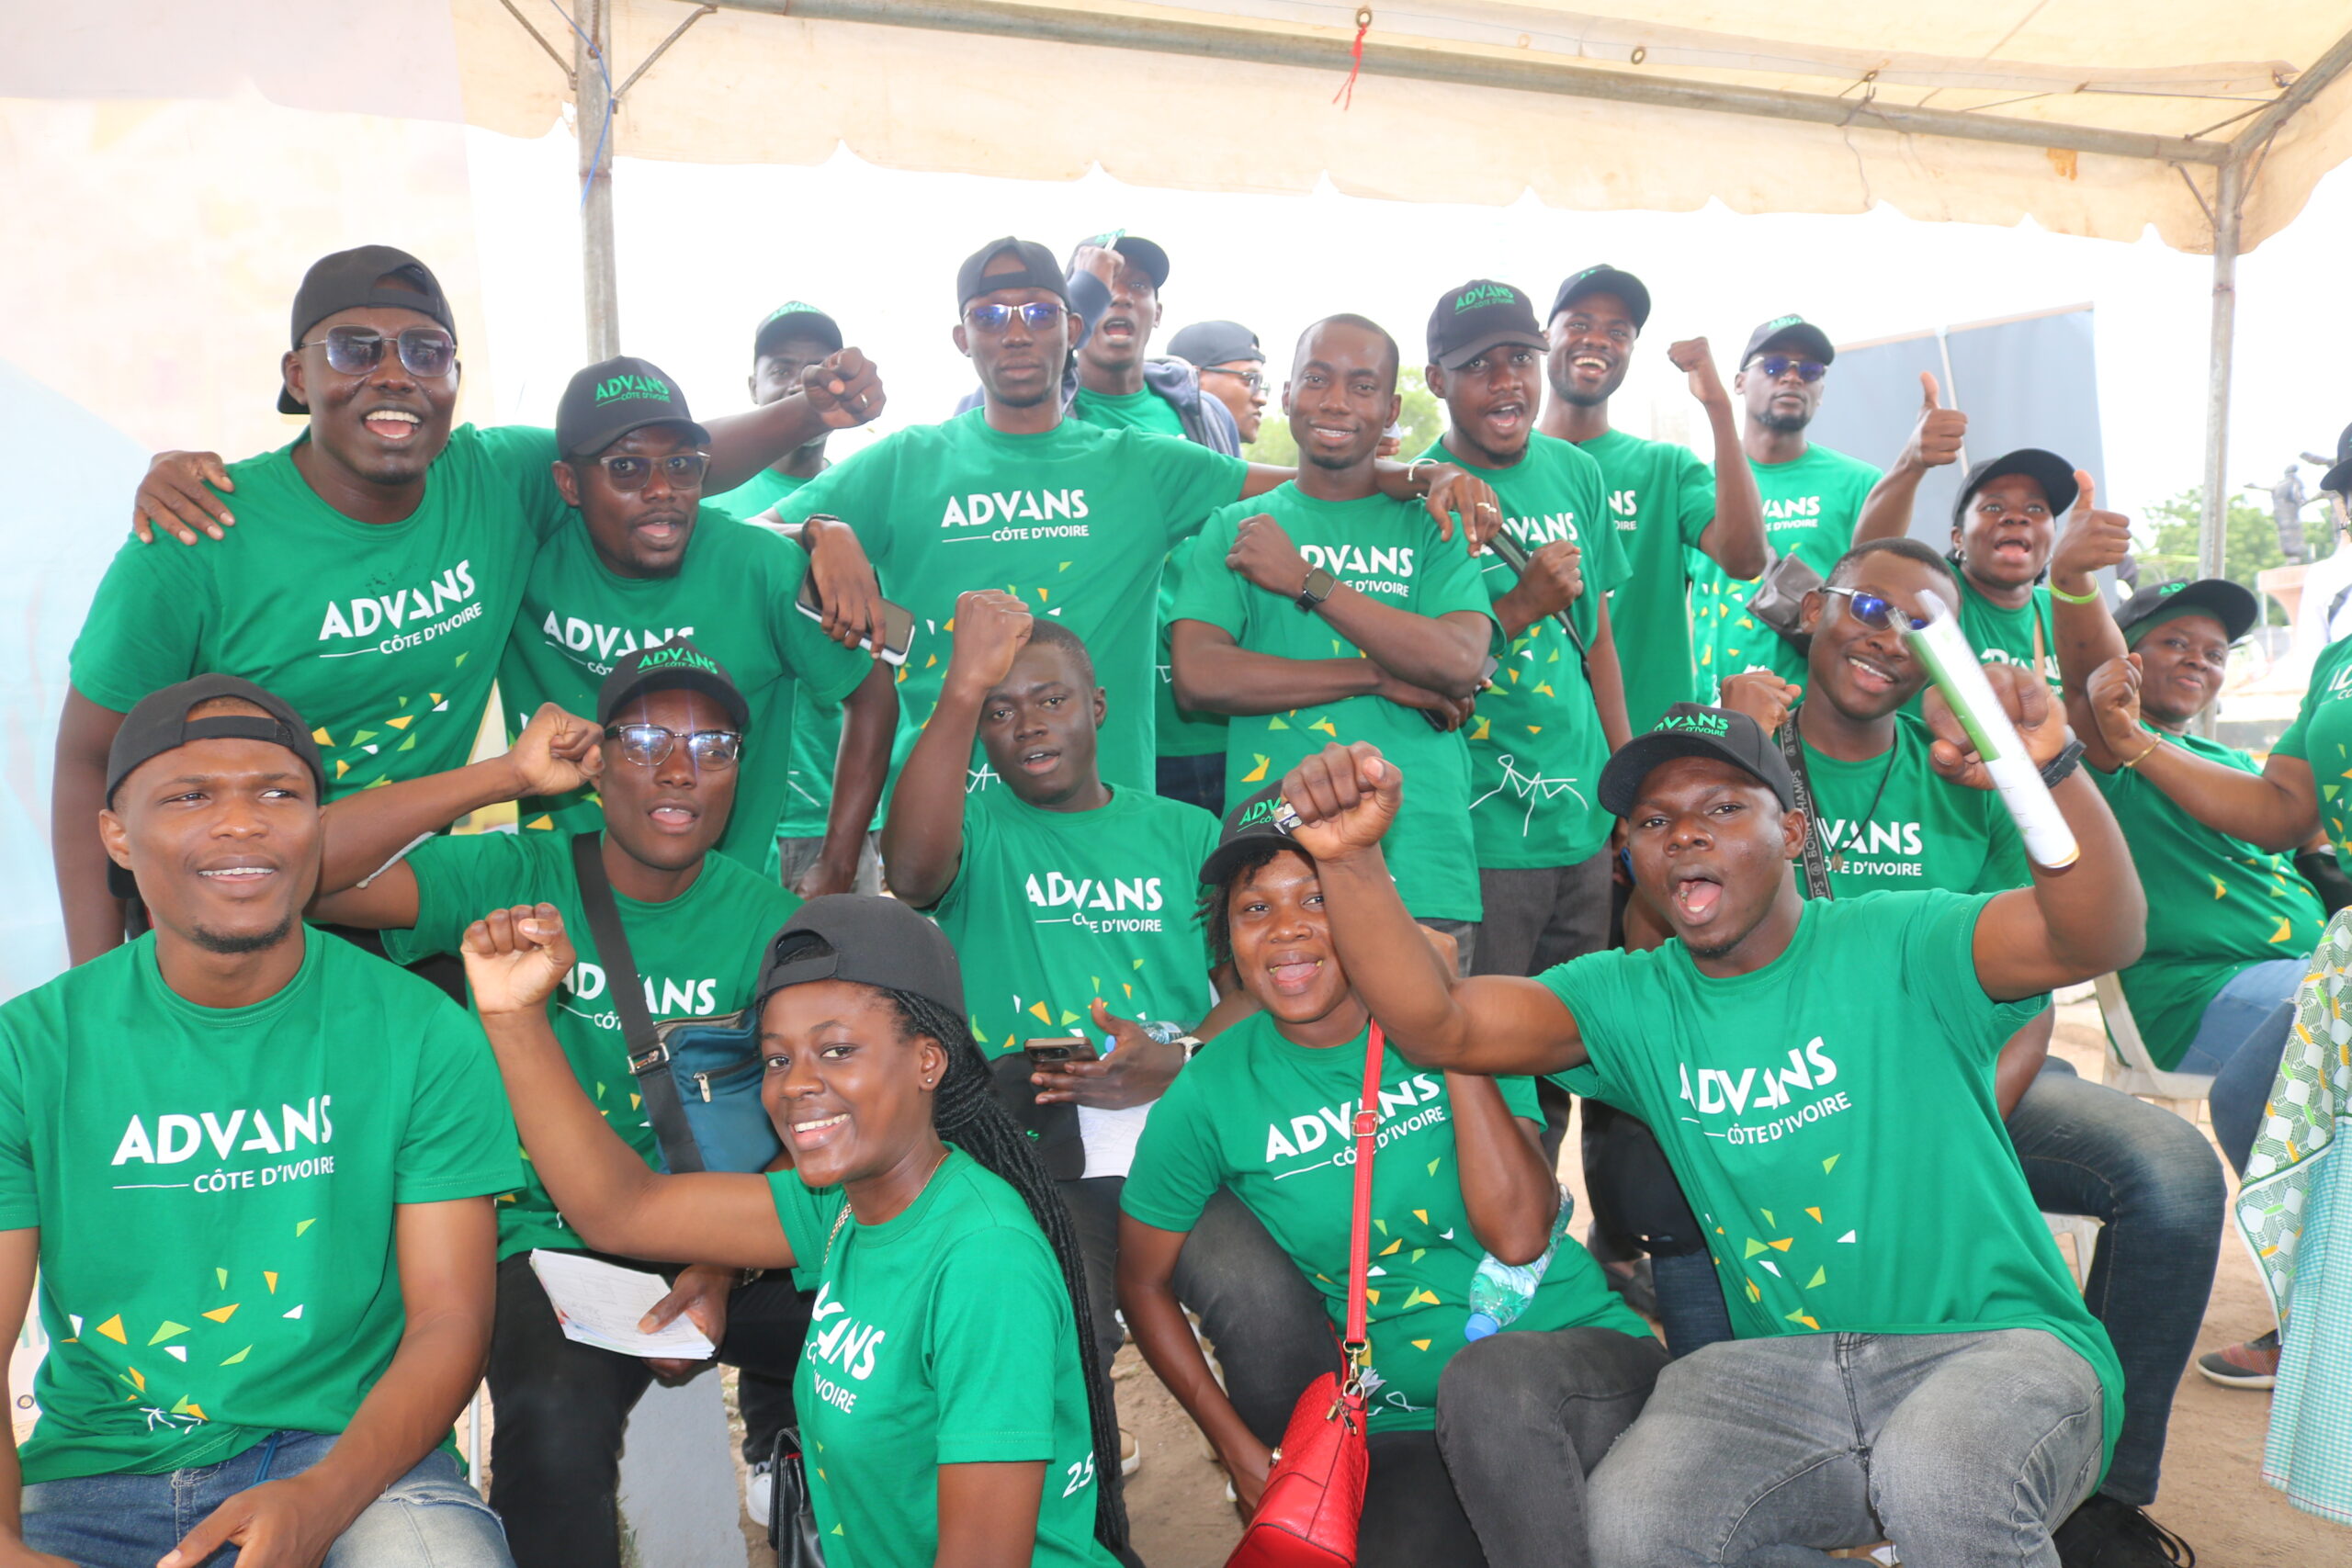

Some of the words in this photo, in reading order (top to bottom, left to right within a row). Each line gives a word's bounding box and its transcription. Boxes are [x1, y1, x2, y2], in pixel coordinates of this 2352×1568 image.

[1455, 284, 1514, 310] ADVANS
[1768, 316, 1802, 330] ADV
[595, 374, 670, 401] ADVANS
[941, 489, 1090, 528] ADVANS
[992, 526, 1029, 542] CÔTE
[1031, 525, 1090, 539] D'IVOIRE
[1300, 544, 1414, 578] DVANS
[318, 558, 476, 641] ADVANS
[1356, 580, 1409, 597] D'IVOIRE
[379, 633, 423, 655] CÔTE
[424, 602, 484, 641] D'IVOIRE
[637, 648, 718, 674] ADVANS
[1654, 712, 1729, 732] VANS
[1238, 796, 1282, 826] ADV
[1815, 817, 1923, 856] VANS
[1853, 861, 1923, 876] D'IVOIRE
[1025, 872, 1163, 911] ADVANS
[1102, 919, 1163, 933] D'IVOIRE
[1679, 1035, 1838, 1116] ADVANS
[110, 1094, 333, 1167] ADVANS
[1377, 1106, 1446, 1149] D'IVOIRE
[1727, 1122, 1770, 1145] CÔTE
[1769, 1091, 1852, 1141] D'IVOIRE
[193, 1168, 255, 1193] CÔTE
[261, 1156, 335, 1187] D'IVOIRE
[812, 1280, 886, 1381] VANS
[1062, 1450, 1094, 1499] 25
